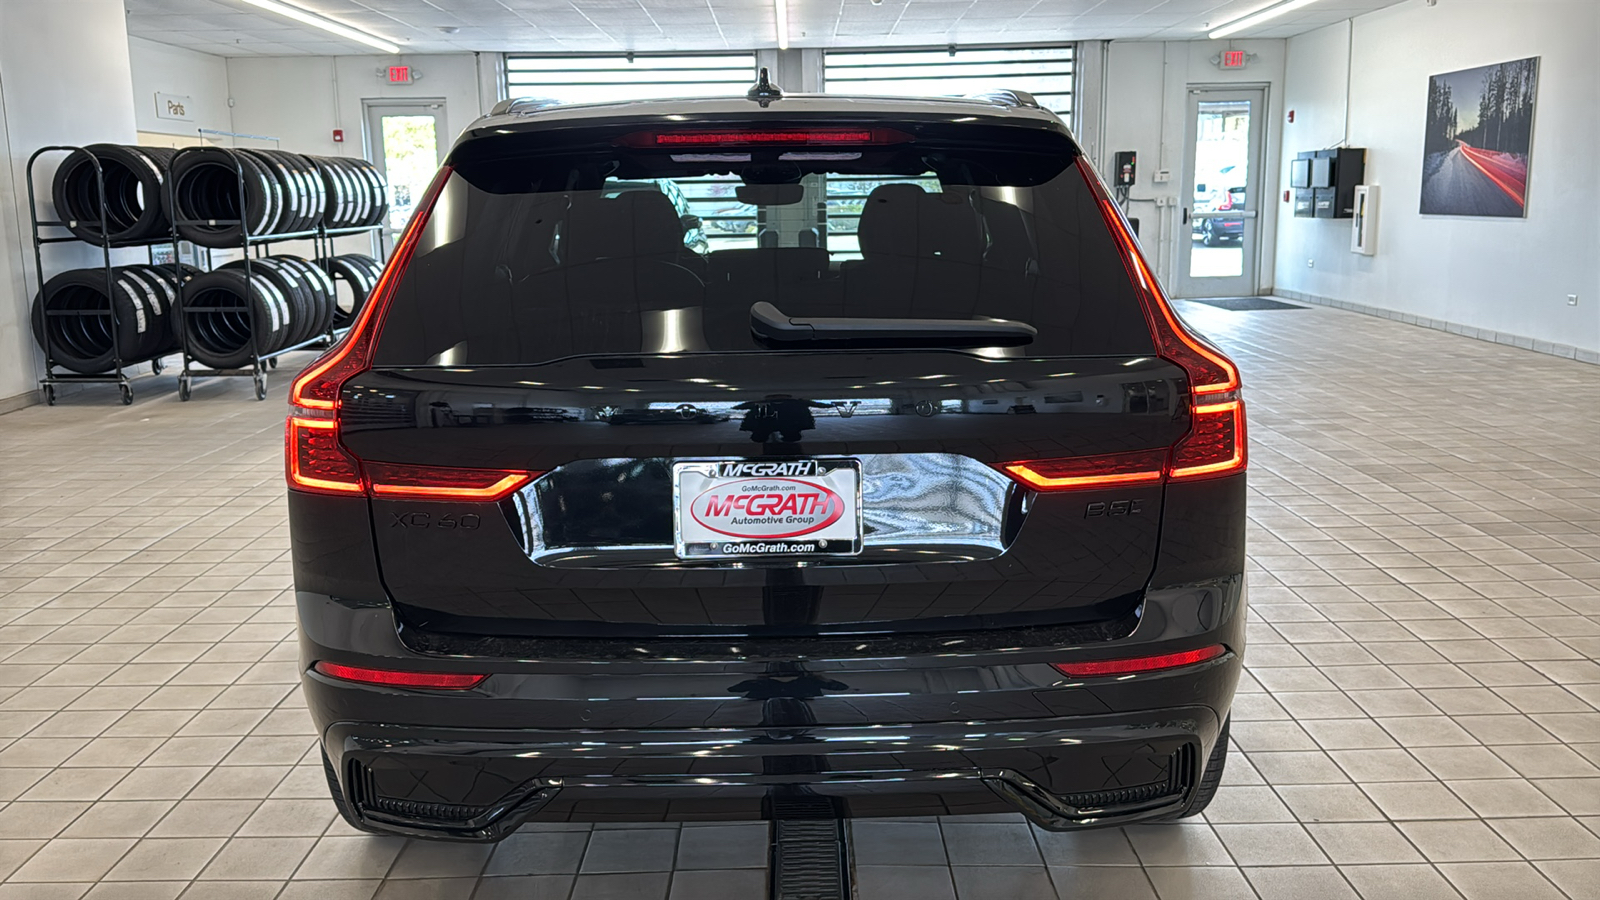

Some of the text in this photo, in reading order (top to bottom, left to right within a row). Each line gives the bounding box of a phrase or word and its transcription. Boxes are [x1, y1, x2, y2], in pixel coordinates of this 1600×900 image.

[1225, 51, 1243, 66] EXIT
[389, 66, 408, 81] EXIT
[167, 100, 186, 116] Parts
[723, 462, 811, 476] McGRATH
[704, 493, 830, 517] McGRATH
[730, 515, 815, 525] Automotive Group
[722, 543, 815, 553] GoMcGrath.com
